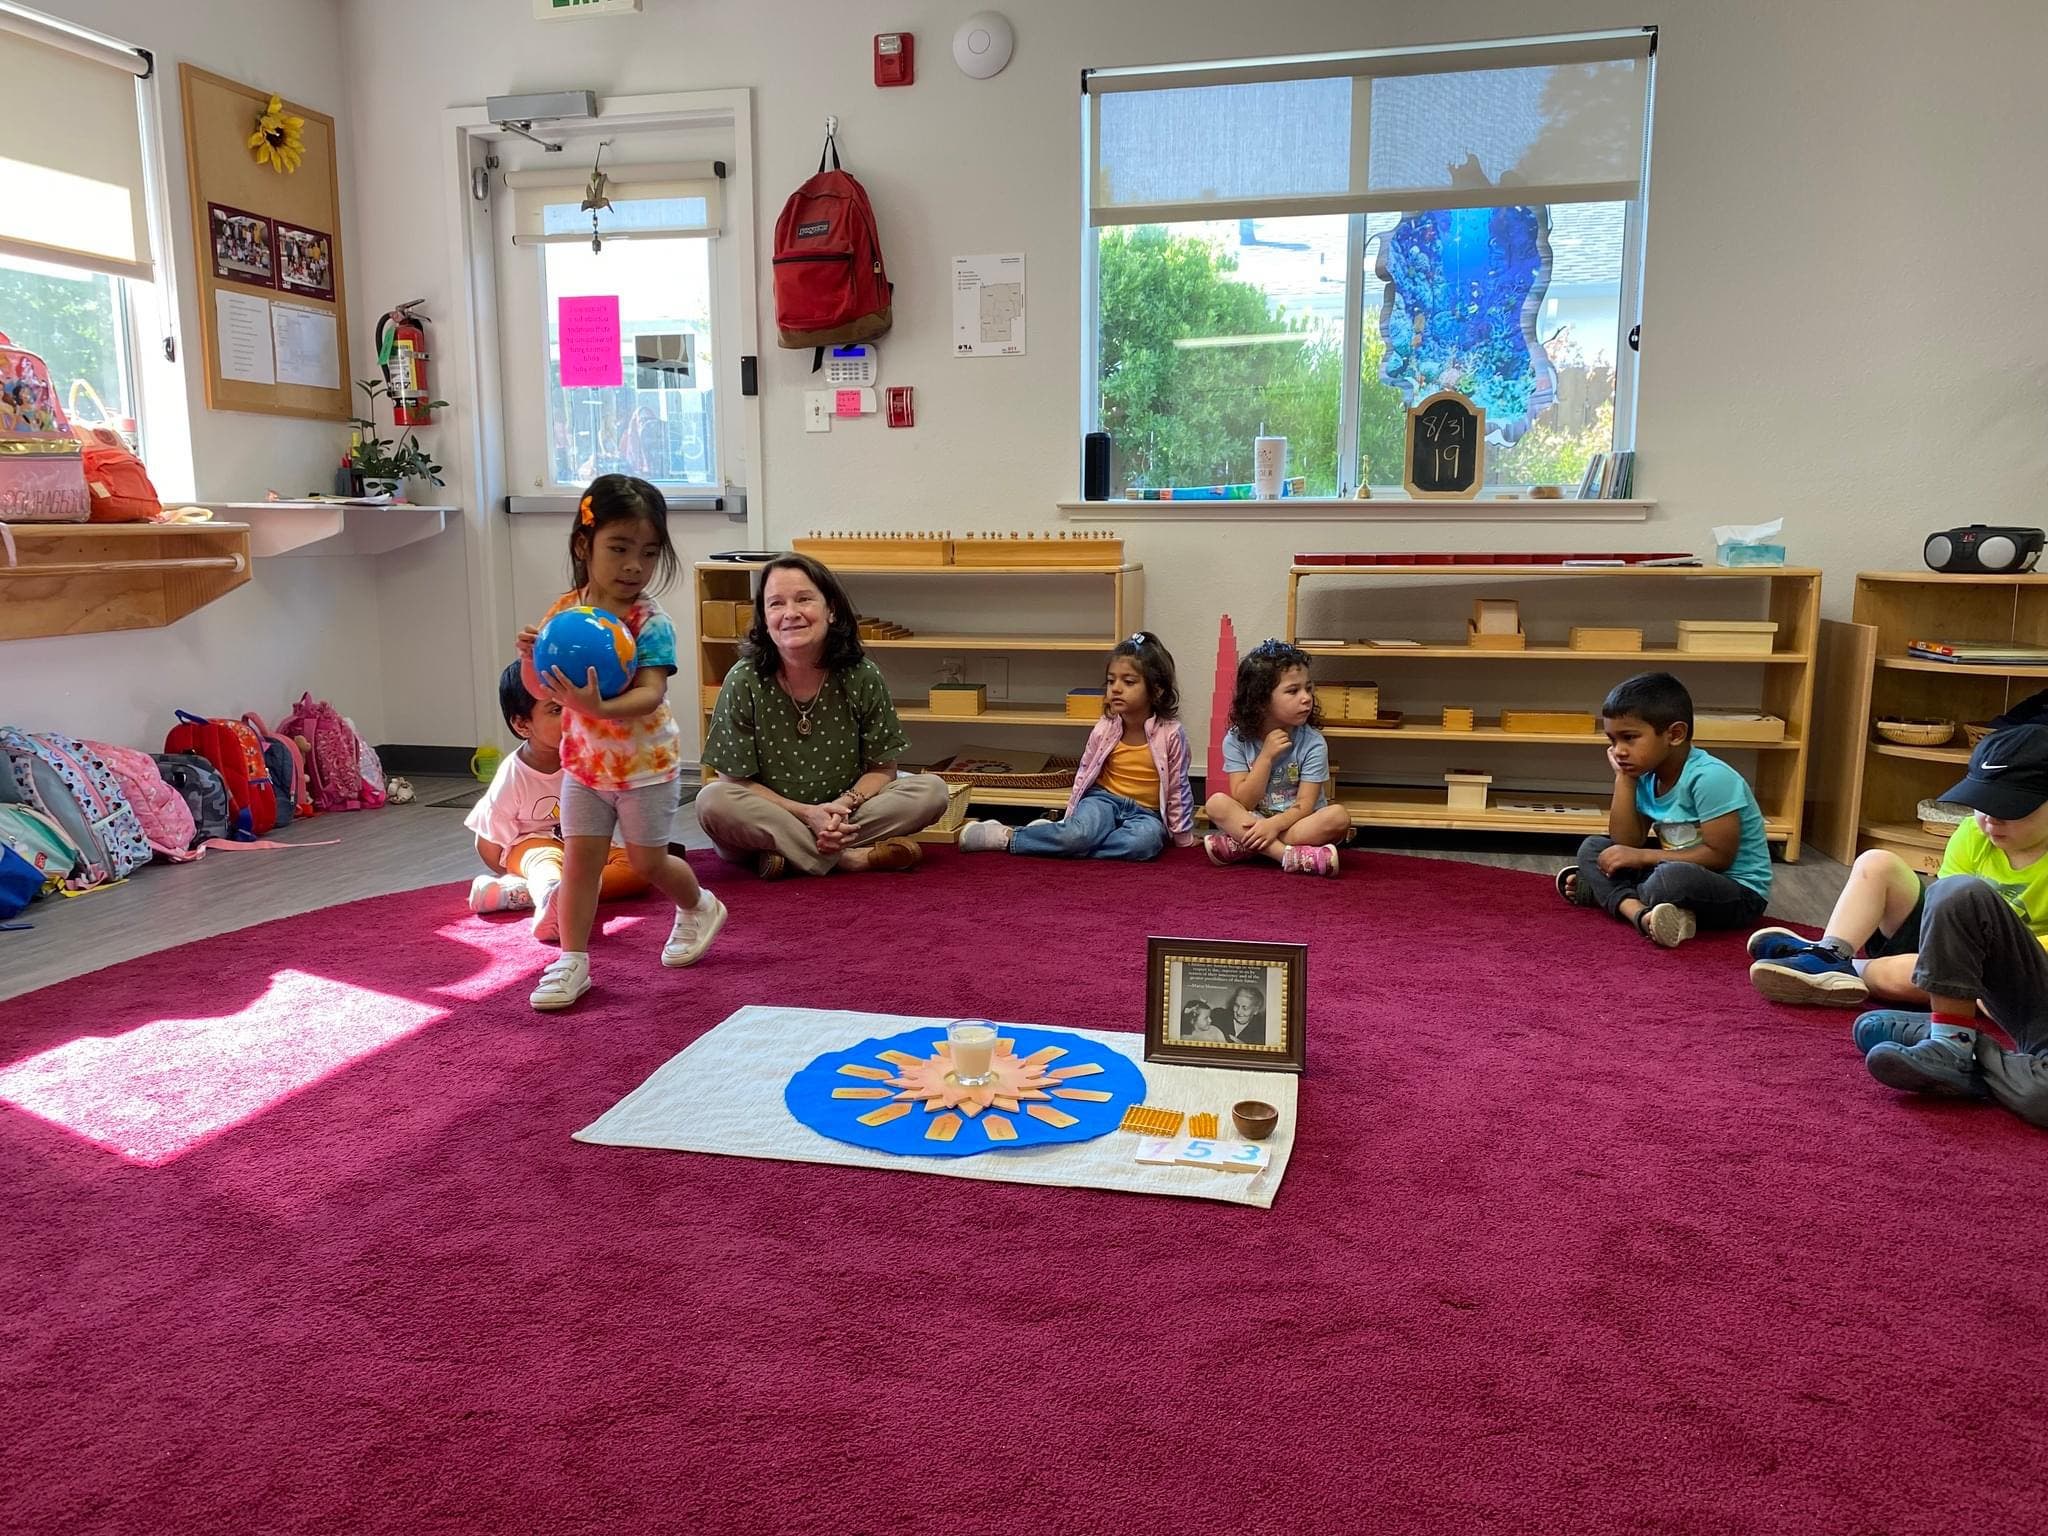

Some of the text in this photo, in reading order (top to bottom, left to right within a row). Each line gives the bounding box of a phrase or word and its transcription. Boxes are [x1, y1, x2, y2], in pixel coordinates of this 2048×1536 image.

[1422, 412, 1465, 442] 8/31
[1435, 444, 1460, 482] 19
[1184, 1140, 1215, 1158] 5
[1231, 1144, 1261, 1161] 3
